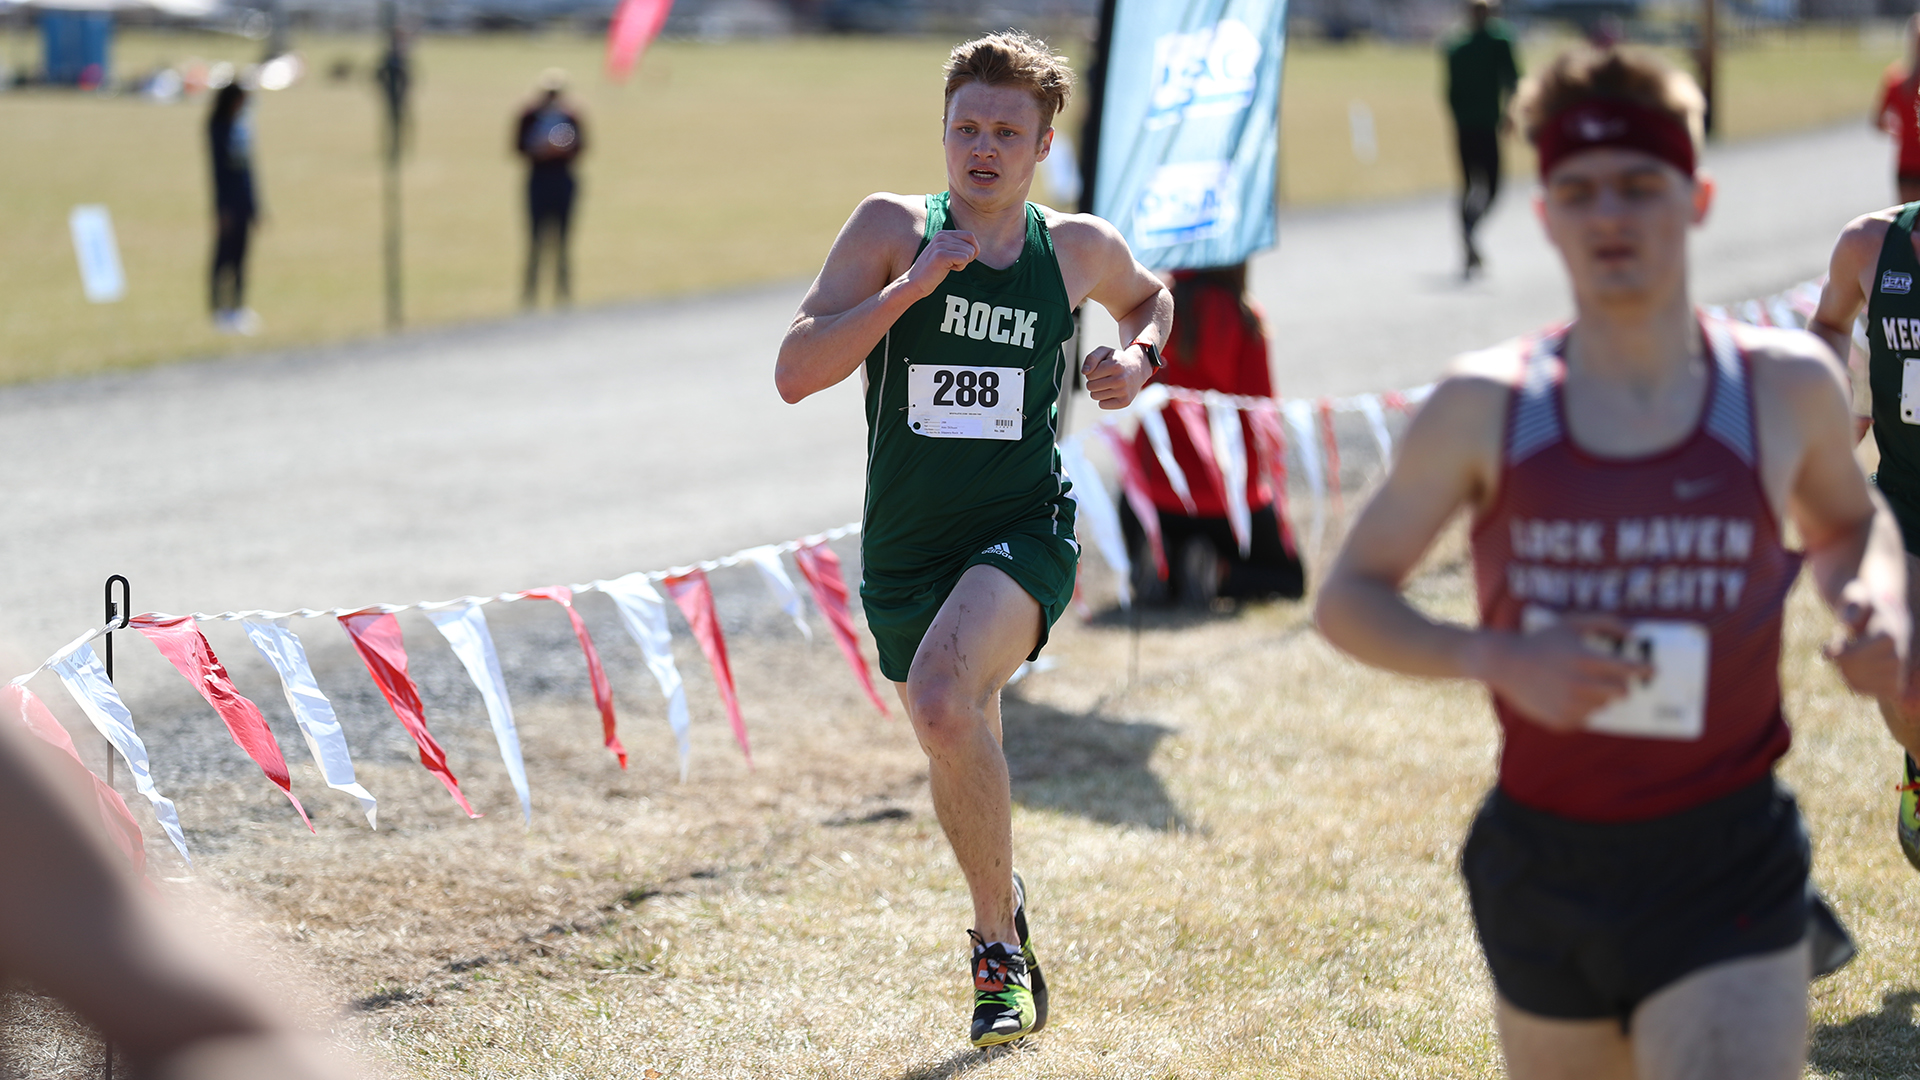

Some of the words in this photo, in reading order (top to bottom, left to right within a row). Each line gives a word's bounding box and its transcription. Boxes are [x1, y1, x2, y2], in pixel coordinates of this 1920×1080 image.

[940, 294, 1038, 349] ROCK
[1882, 317, 1920, 350] MER
[933, 370, 1000, 408] 288
[981, 547, 1013, 560] adidas
[1508, 516, 1604, 563] LOCK
[1615, 515, 1754, 563] HAVEN
[1506, 563, 1747, 614] UNIVERSITY
